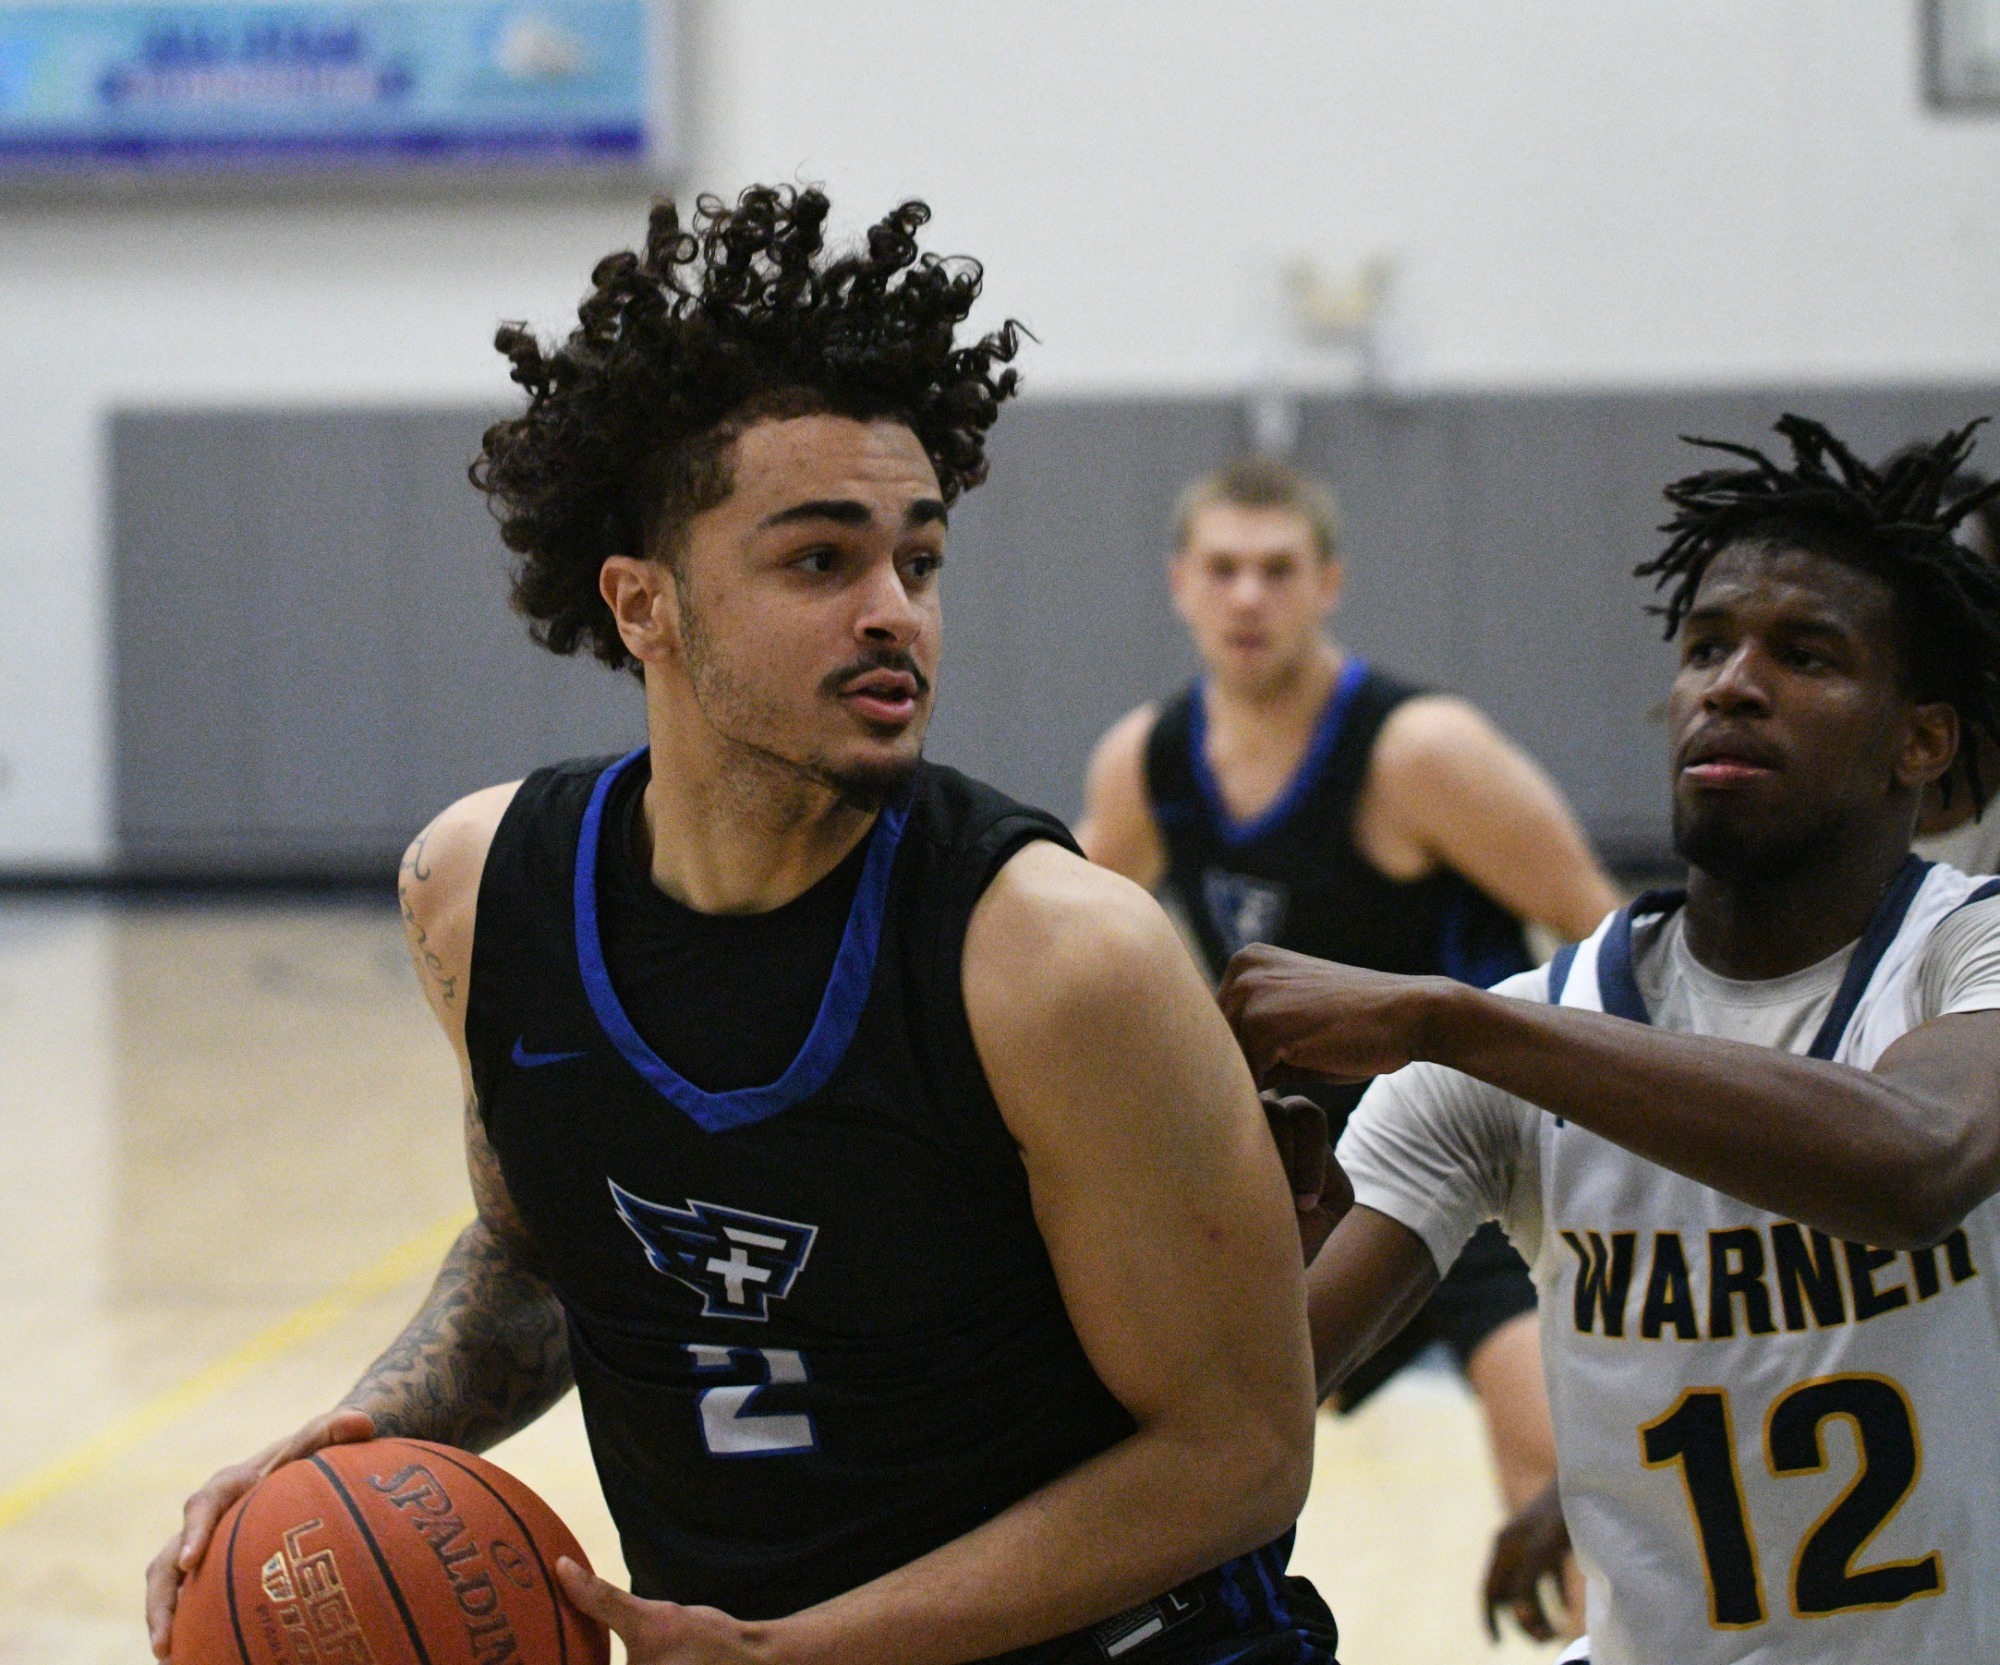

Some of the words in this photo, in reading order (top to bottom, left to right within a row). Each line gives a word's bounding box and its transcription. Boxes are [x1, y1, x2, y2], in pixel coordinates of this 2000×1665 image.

[1561, 1222, 1978, 1341] WARNER
[680, 1343, 820, 1458] 2
[1637, 1371, 1946, 1630] 12
[1168, 1593, 1189, 1611] L
